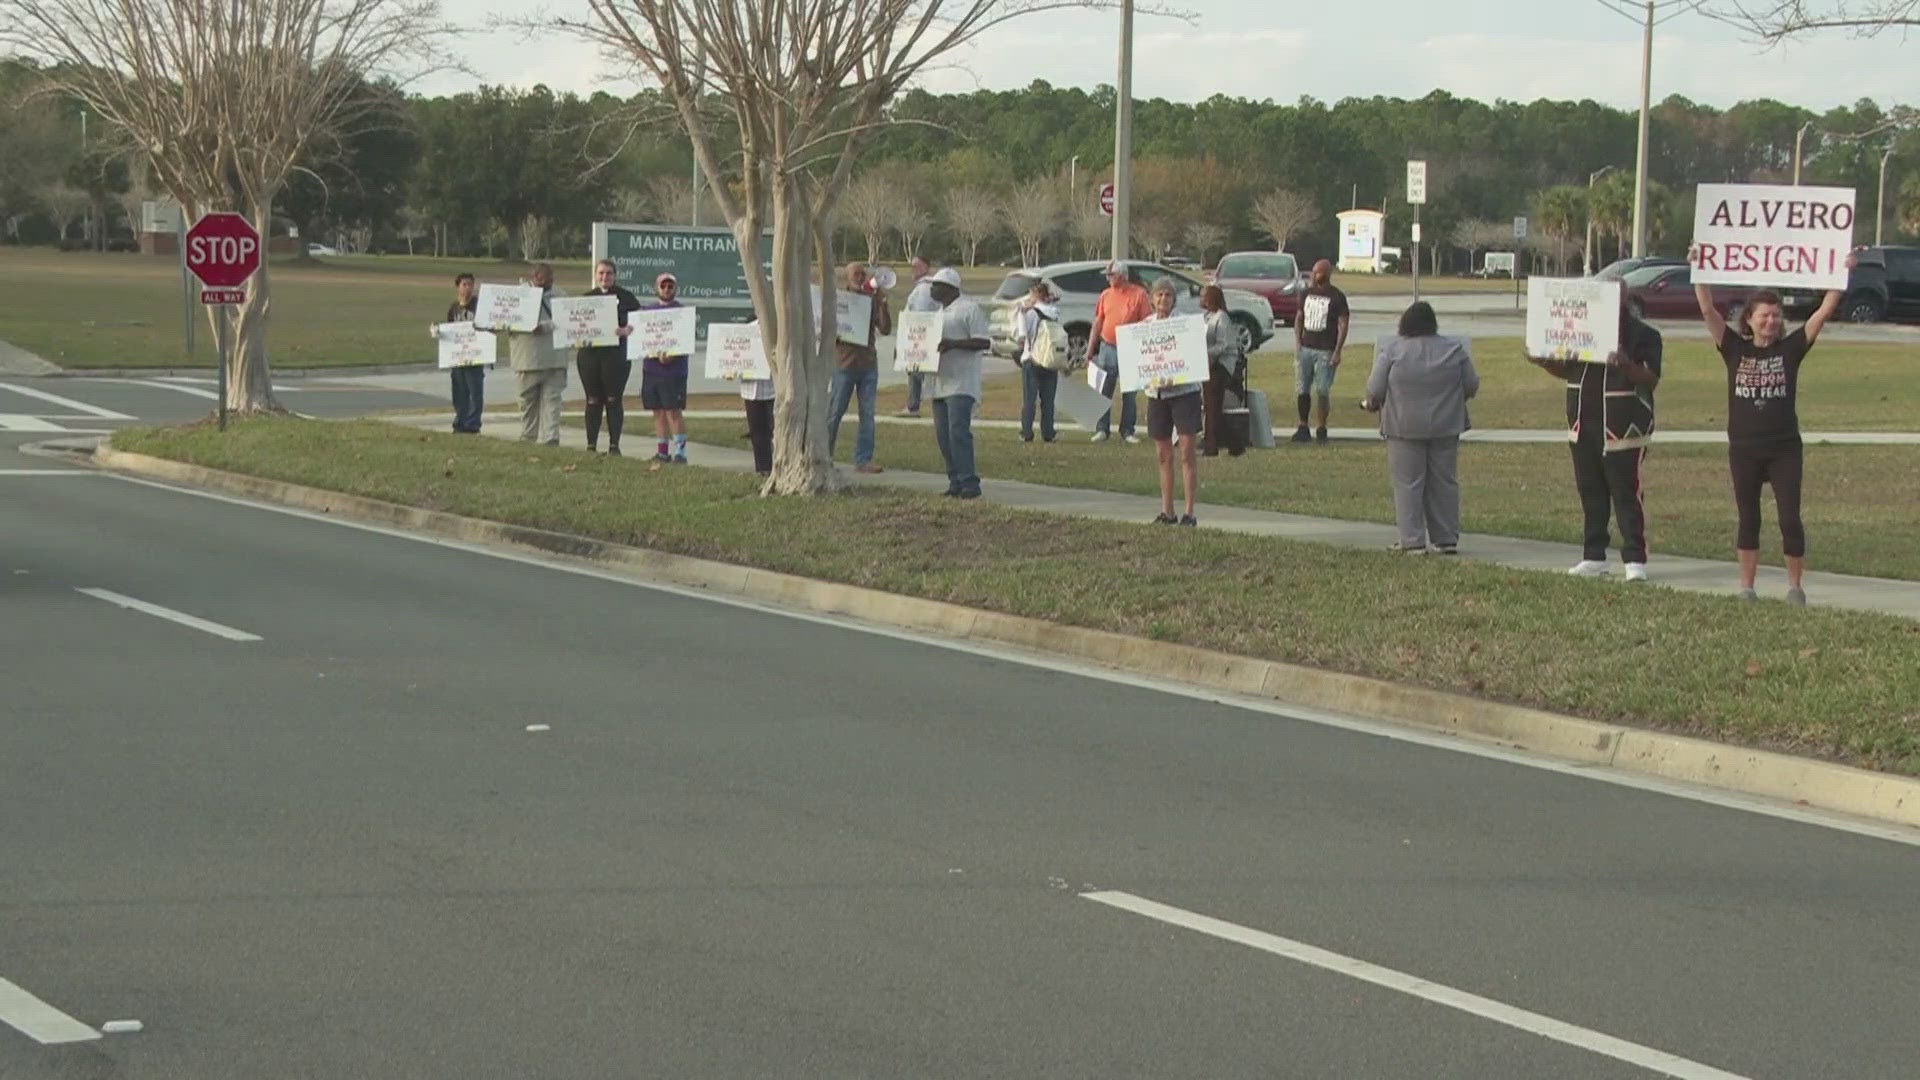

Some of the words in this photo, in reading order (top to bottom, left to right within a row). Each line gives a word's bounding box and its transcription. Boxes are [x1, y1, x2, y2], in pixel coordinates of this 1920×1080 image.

[1709, 199, 1854, 230] ALVERO
[629, 235, 669, 250] MAIN
[672, 237, 737, 252] ENTRAN
[190, 236, 256, 265] STOP
[1698, 243, 1818, 274] RESIGN
[616, 270, 633, 280] taff
[204, 292, 219, 303] ALL
[223, 292, 242, 303] WAY
[689, 285, 732, 297] Drop-off
[1141, 335, 1176, 347] RACISM
[1140, 345, 1159, 355] WILL
[1160, 343, 1177, 353] NOT
[1735, 373, 1786, 387] FREEDOM
[1735, 386, 1757, 398] NOT
[1760, 385, 1787, 398] FEAR
